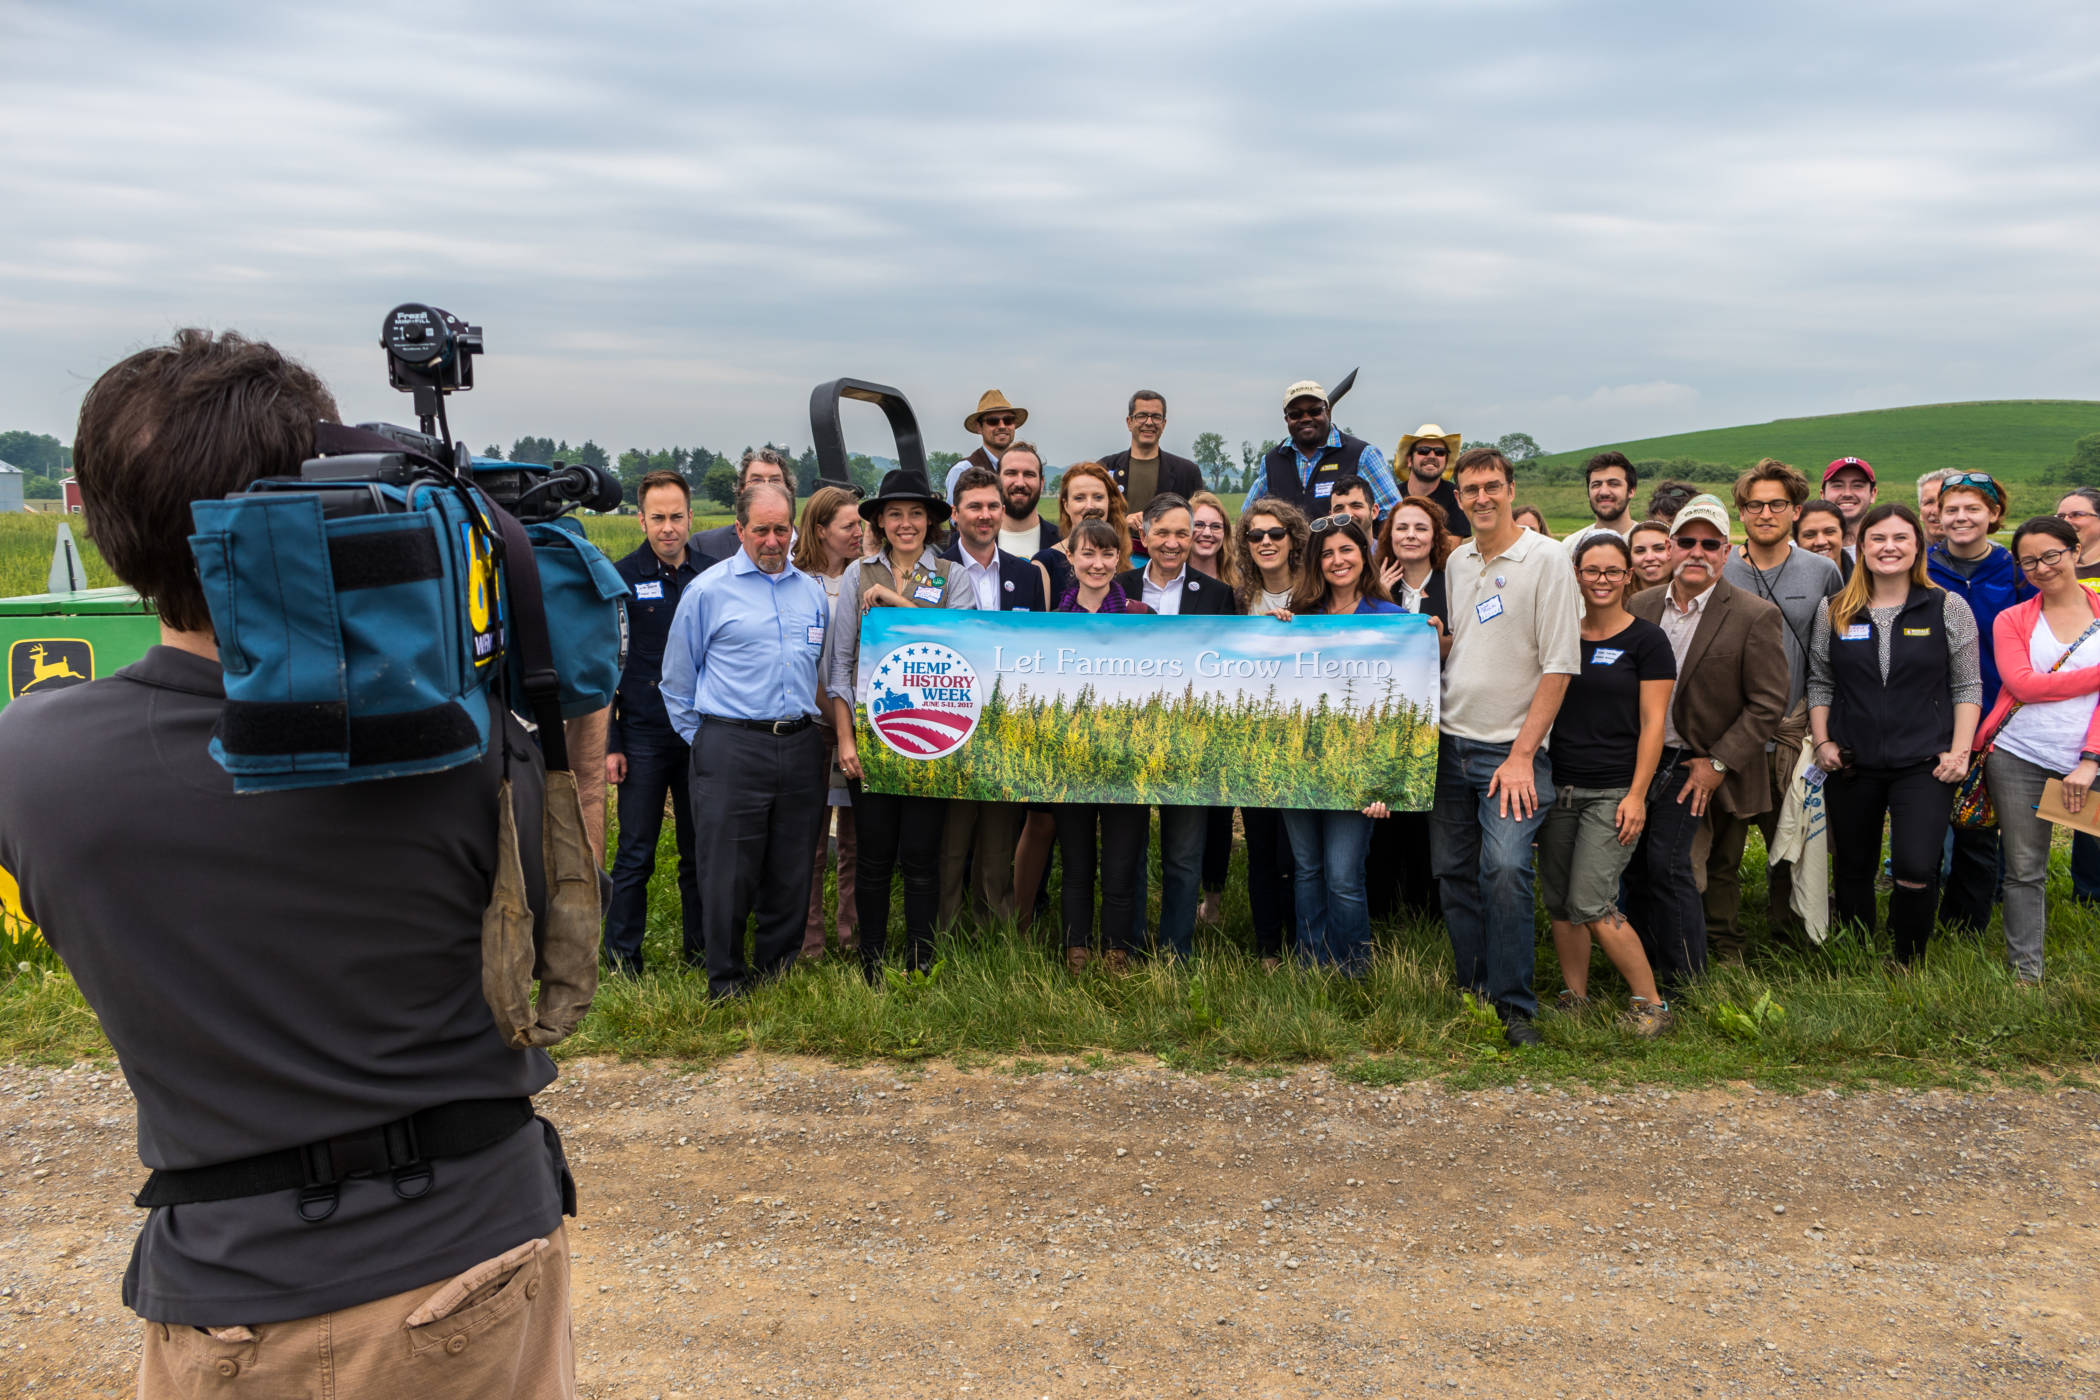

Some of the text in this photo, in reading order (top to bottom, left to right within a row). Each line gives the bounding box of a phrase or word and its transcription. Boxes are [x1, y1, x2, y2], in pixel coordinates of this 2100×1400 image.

[903, 662, 952, 674] HEMP
[993, 645, 1393, 684] Let Farmers Grow Hemp
[902, 675, 975, 688] HISTORY
[922, 688, 971, 701] WEEK
